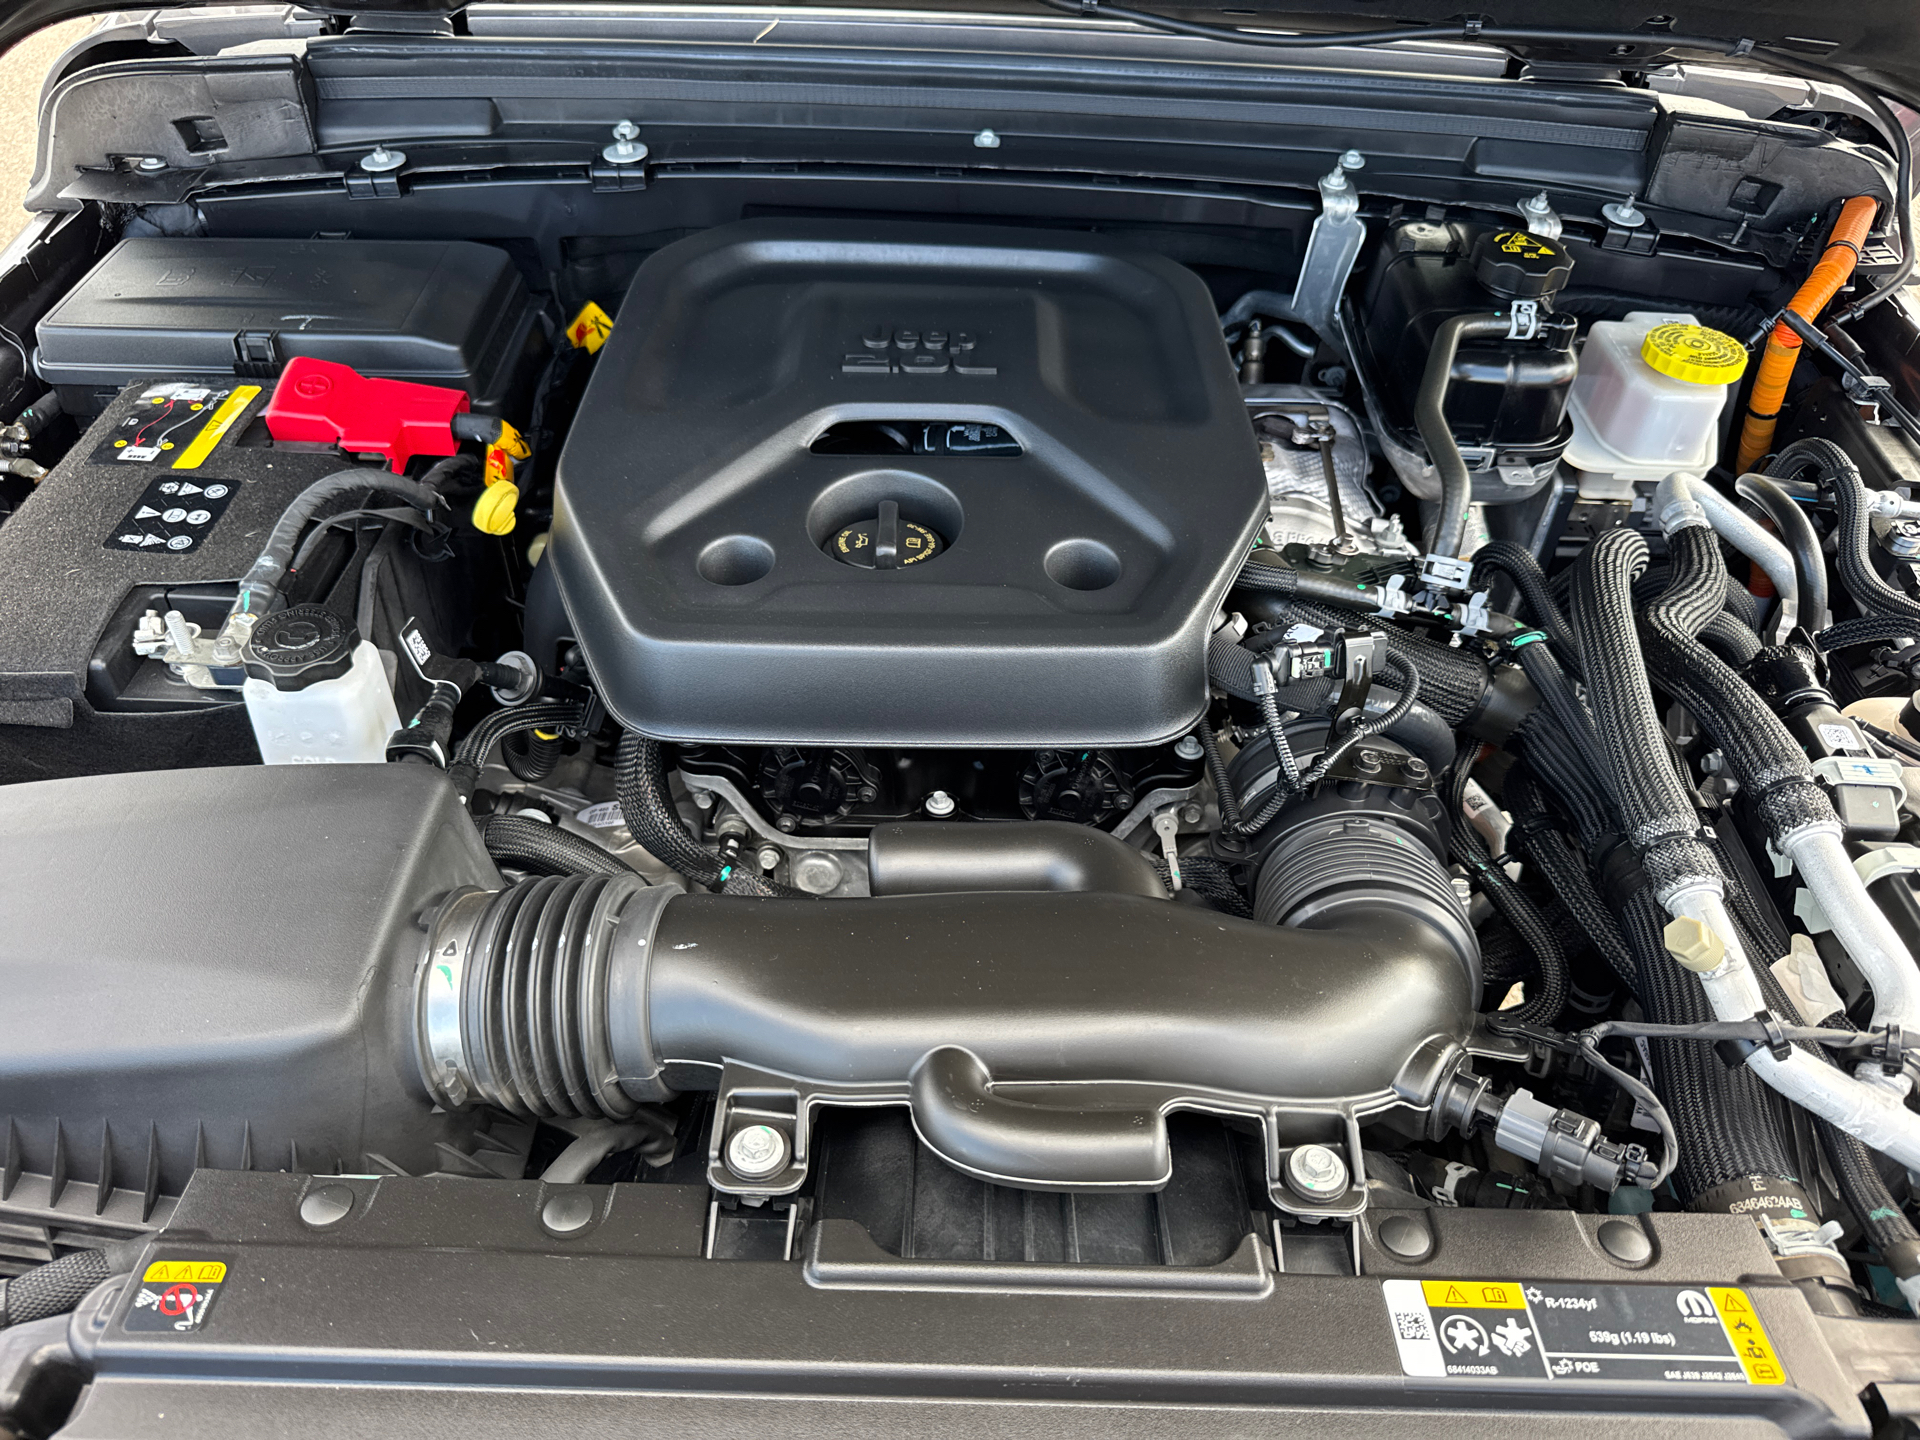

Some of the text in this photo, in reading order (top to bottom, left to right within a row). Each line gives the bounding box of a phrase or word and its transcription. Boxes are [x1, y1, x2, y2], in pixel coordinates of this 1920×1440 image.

[862, 325, 977, 354] Jeep
[842, 353, 997, 375] 2.0L
[1544, 1297, 1598, 1312] R-1234yf
[1588, 1331, 1677, 1347] 539g (1.19 lbs)
[1574, 1361, 1601, 1374] POE
